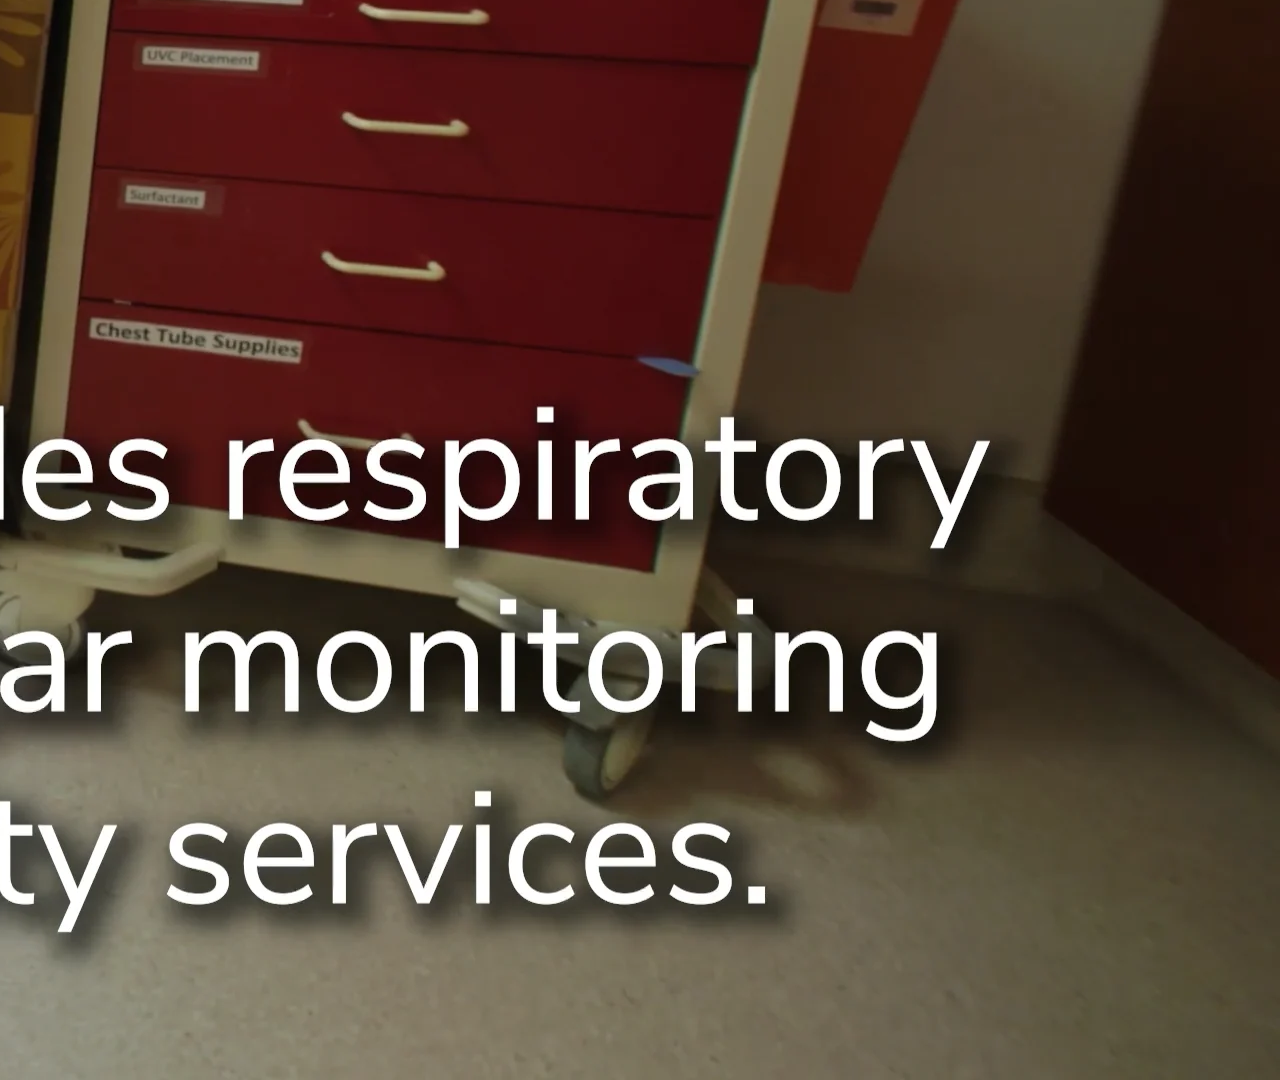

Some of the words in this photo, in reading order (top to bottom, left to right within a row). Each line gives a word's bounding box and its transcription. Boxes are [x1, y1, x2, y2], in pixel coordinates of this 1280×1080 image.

[147, 50, 176, 62] UVC
[181, 52, 254, 66] Placement
[130, 190, 200, 205] Surfactant
[95, 322, 150, 341] Chest
[157, 327, 206, 347] Tube
[213, 334, 300, 358] Supplies
